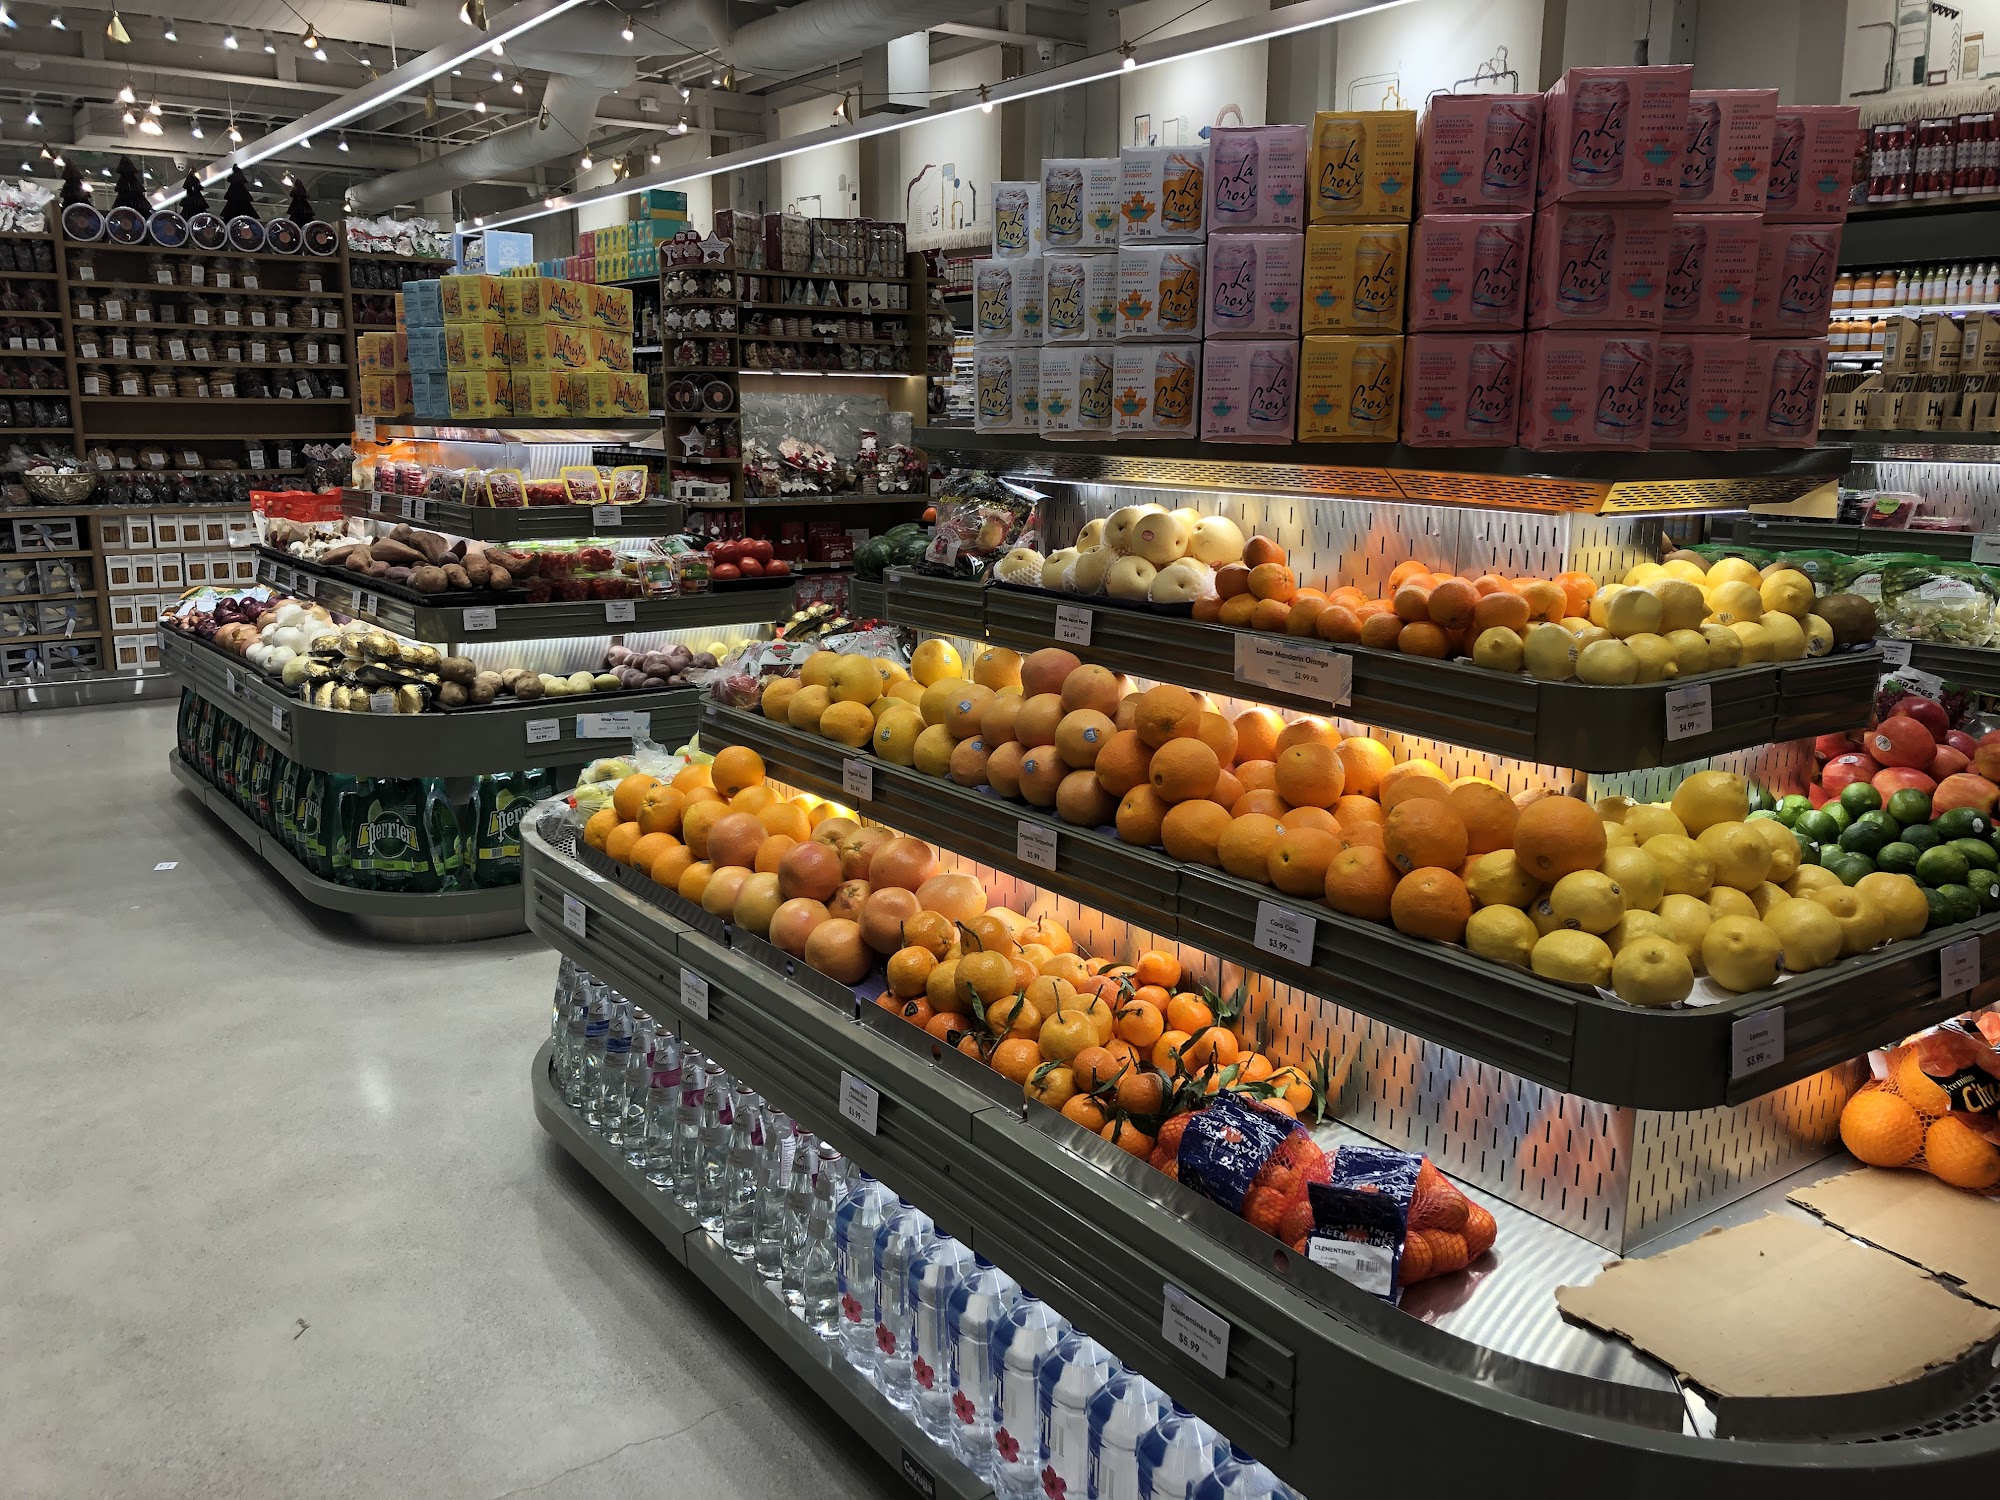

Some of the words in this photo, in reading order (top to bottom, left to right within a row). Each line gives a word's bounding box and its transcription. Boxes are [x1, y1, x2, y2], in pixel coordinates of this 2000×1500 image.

[1594, 102, 1622, 138] La
[1505, 123, 1528, 156] La
[1572, 130, 1624, 165] Croix
[1686, 121, 1712, 155] La
[1338, 140, 1360, 170] La
[1484, 148, 1530, 180] Croix
[1772, 137, 1798, 168] La
[1232, 154, 1254, 184] La
[1320, 163, 1364, 193] Croix
[1656, 178, 1665, 186] 355
[1064, 184, 1078, 209] La
[1179, 170, 1198, 197] La
[1216, 177, 1256, 206] Croix
[1732, 189, 1738, 197] 8
[1010, 204, 1025, 226] La
[1049, 204, 1082, 226] Croix
[1164, 189, 1200, 215] Croix
[998, 223, 1029, 244] Croix
[1494, 244, 1517, 276] La
[1582, 235, 1608, 269] La
[1674, 244, 1699, 277] La
[1230, 261, 1252, 290] La
[1373, 254, 1395, 283] La
[1560, 260, 1610, 294] Croix
[1802, 252, 1826, 283] La
[992, 284, 1008, 306] La
[1063, 280, 1081, 304] La
[1176, 269, 1194, 297] La
[1214, 283, 1254, 311] Croix
[1354, 276, 1398, 306] Croix
[1473, 268, 1520, 300] Croix
[1781, 275, 1828, 306] Croix
[980, 302, 1012, 323] Croix
[1050, 299, 1084, 322] Croix
[1161, 289, 1197, 315] Croix
[992, 371, 1008, 394] La
[1094, 370, 1112, 394] La
[1171, 368, 1190, 394] La
[1266, 366, 1288, 394] La
[1369, 364, 1390, 392] La
[1487, 362, 1510, 394] La
[1620, 362, 1644, 396] La
[1662, 364, 1686, 396] La
[1790, 367, 1814, 397] La
[980, 389, 1011, 411] Croix
[1156, 388, 1192, 412] Croix
[1250, 387, 1290, 415] Croix
[1351, 385, 1394, 414] Croix
[1468, 385, 1512, 418] Croix
[1598, 386, 1646, 418] Croix
[1769, 389, 1815, 420] Croix
[496, 485, 514, 493] ONE
[1256, 647, 1273, 656] Loose
[1275, 652, 1304, 662] Mandarin
[1305, 657, 1328, 668] Orange
[1672, 704, 1689, 712] Organic
[1680, 722, 1694, 732] $4.99
[1020, 833, 1034, 841] Organic
[1027, 851, 1040, 860] $5.99
[1270, 919, 1283, 928] Cara
[1285, 924, 1298, 933] Cara
[1269, 938, 1288, 951] $3.99
[1750, 1030, 1768, 1040] Lemons
[1747, 1052, 1764, 1067] $3.99
[1941, 1074, 1976, 1095] Premium
[1315, 1244, 1356, 1256] CLEMENTINES
[1171, 1304, 1207, 1334] Clementines
[1209, 1330, 1222, 1345] Bag
[1179, 1332, 1200, 1353] $5.99
